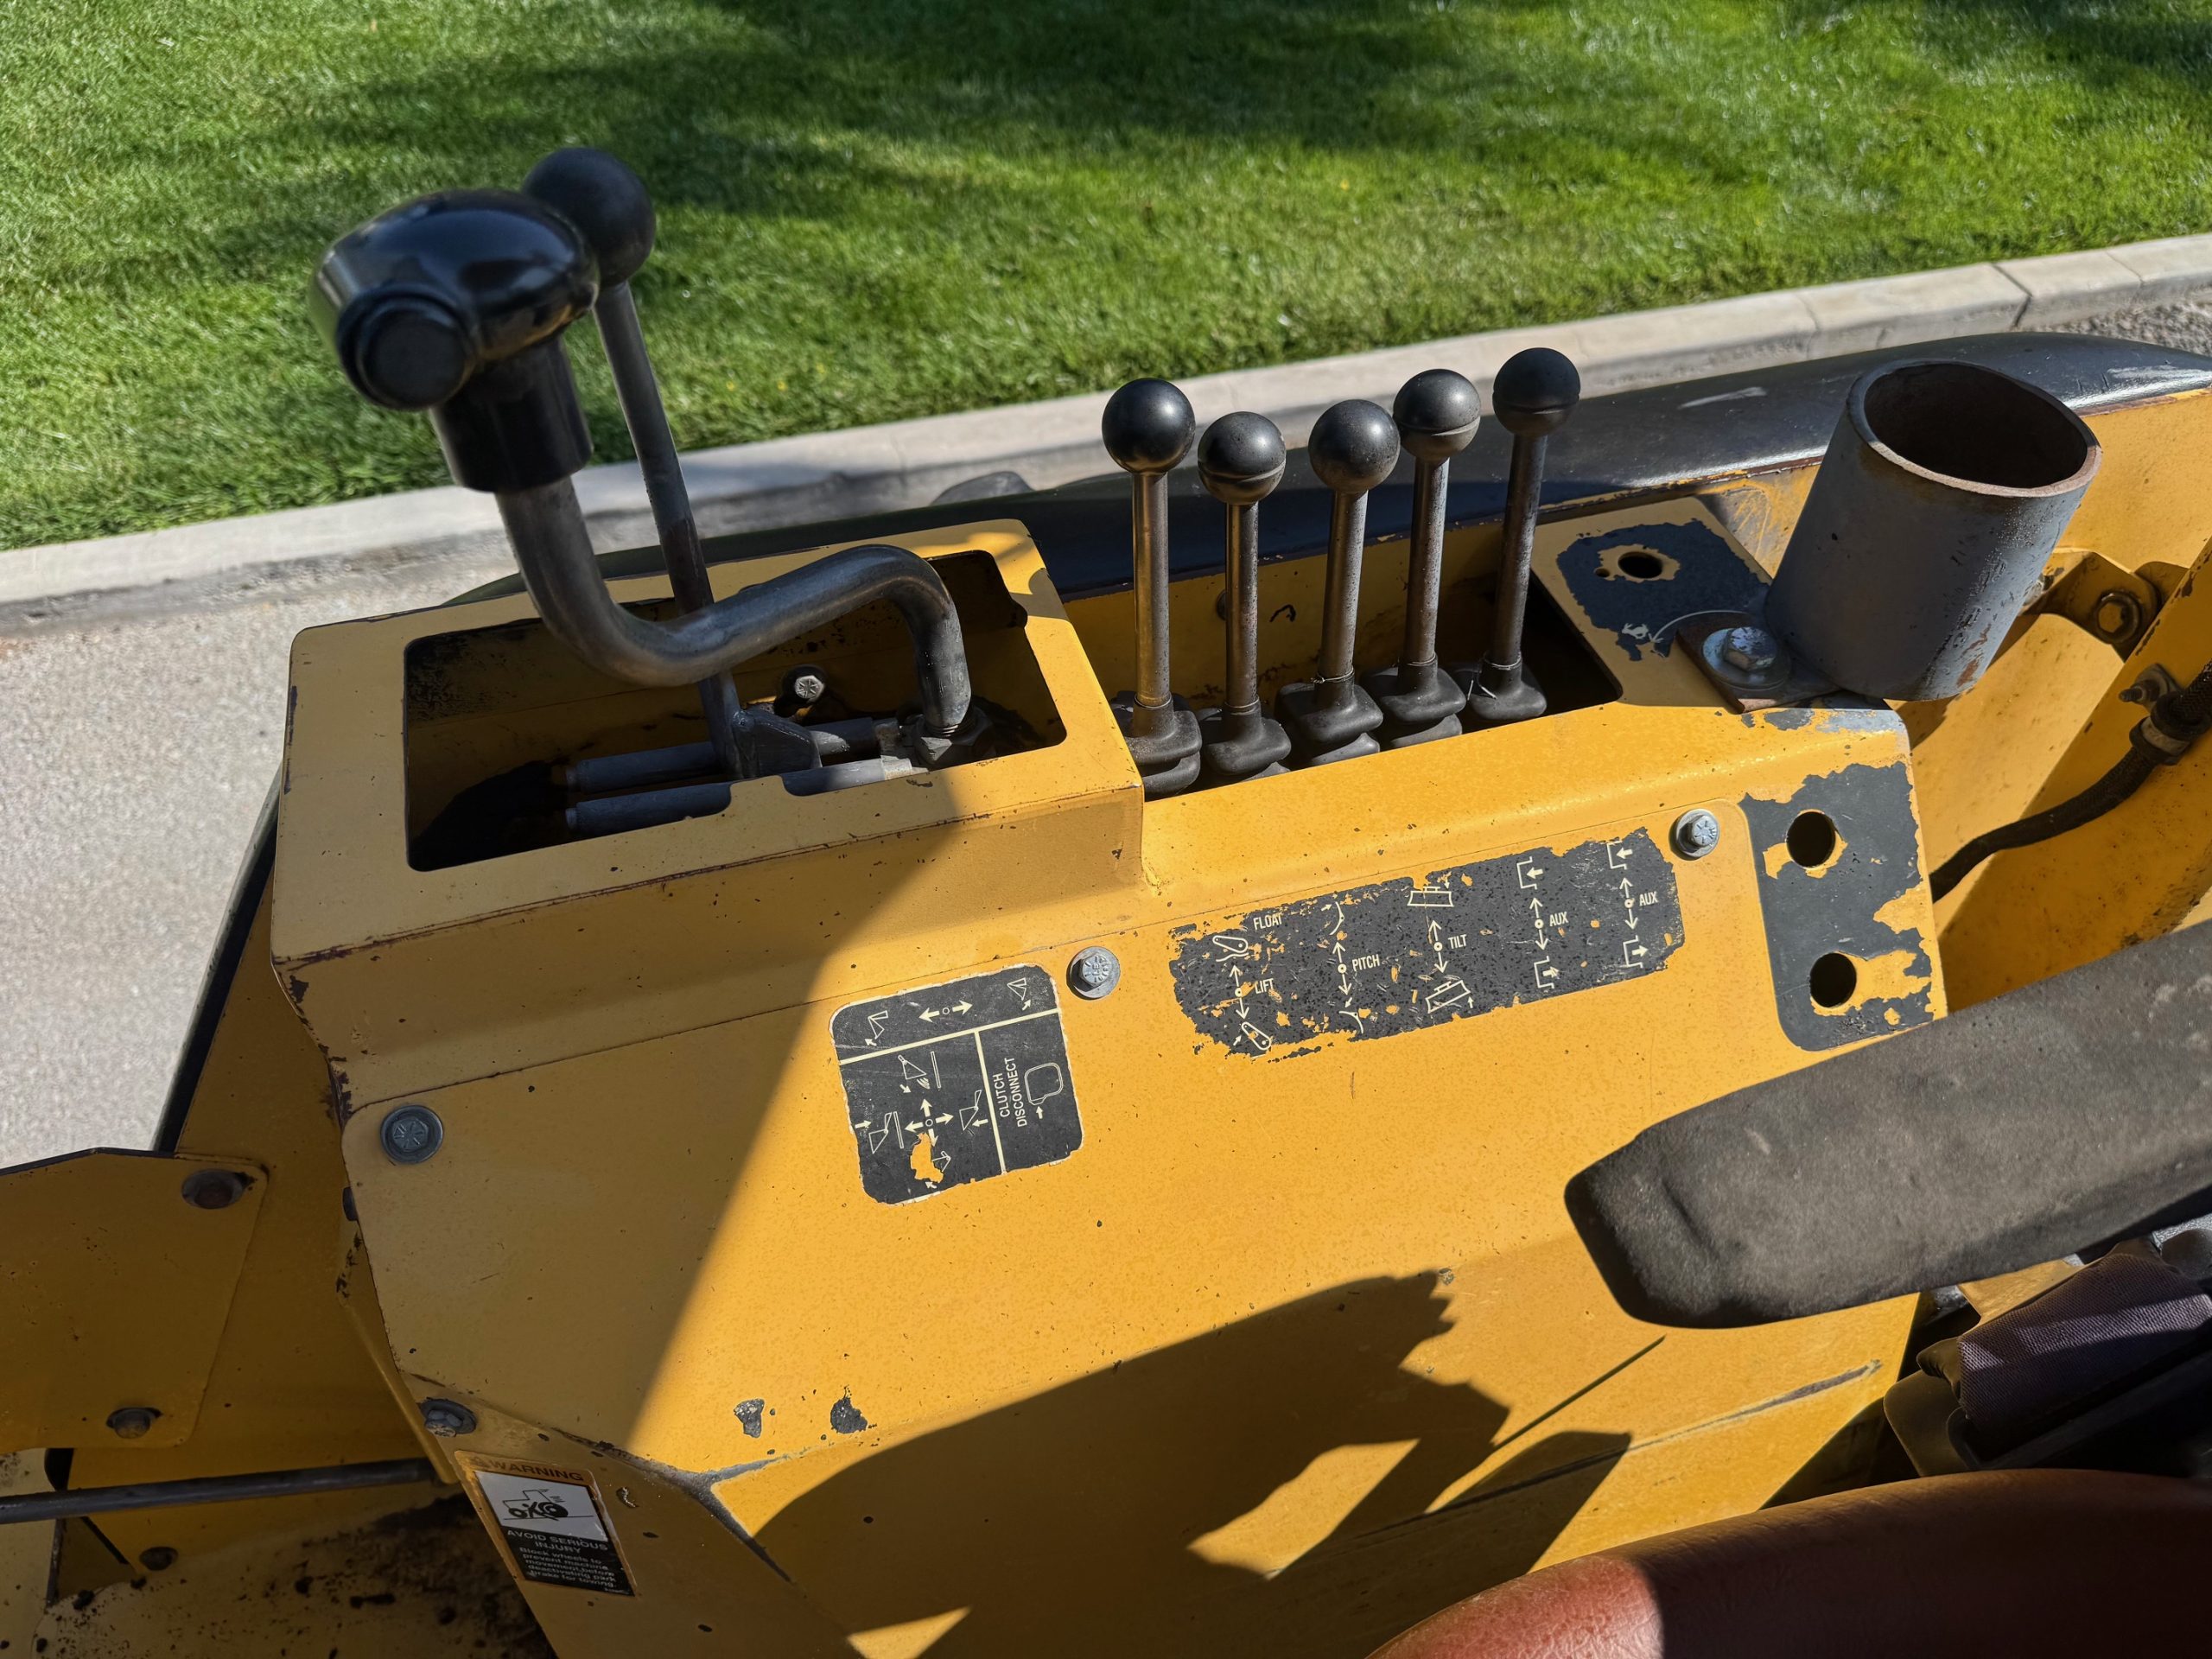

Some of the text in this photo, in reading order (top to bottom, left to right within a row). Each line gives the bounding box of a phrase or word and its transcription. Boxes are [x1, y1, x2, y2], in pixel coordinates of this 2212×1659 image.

[1639, 891, 1658, 906] AUX
[1253, 913, 1283, 931] FLOAT
[1549, 912, 1568, 926] AUX
[1448, 934, 1467, 950] TILT
[1351, 954, 1381, 972] PITCH
[1255, 978, 1274, 995] LIFT
[993, 1073, 1011, 1118] CLUTCH
[1004, 1058, 1027, 1128] DISCONNECT
[489, 1460, 584, 1481] WARNING
[507, 1529, 608, 1551] AVOID SERIOUS
[535, 1541, 582, 1554] INJURY
[519, 1547, 550, 1556] Block
